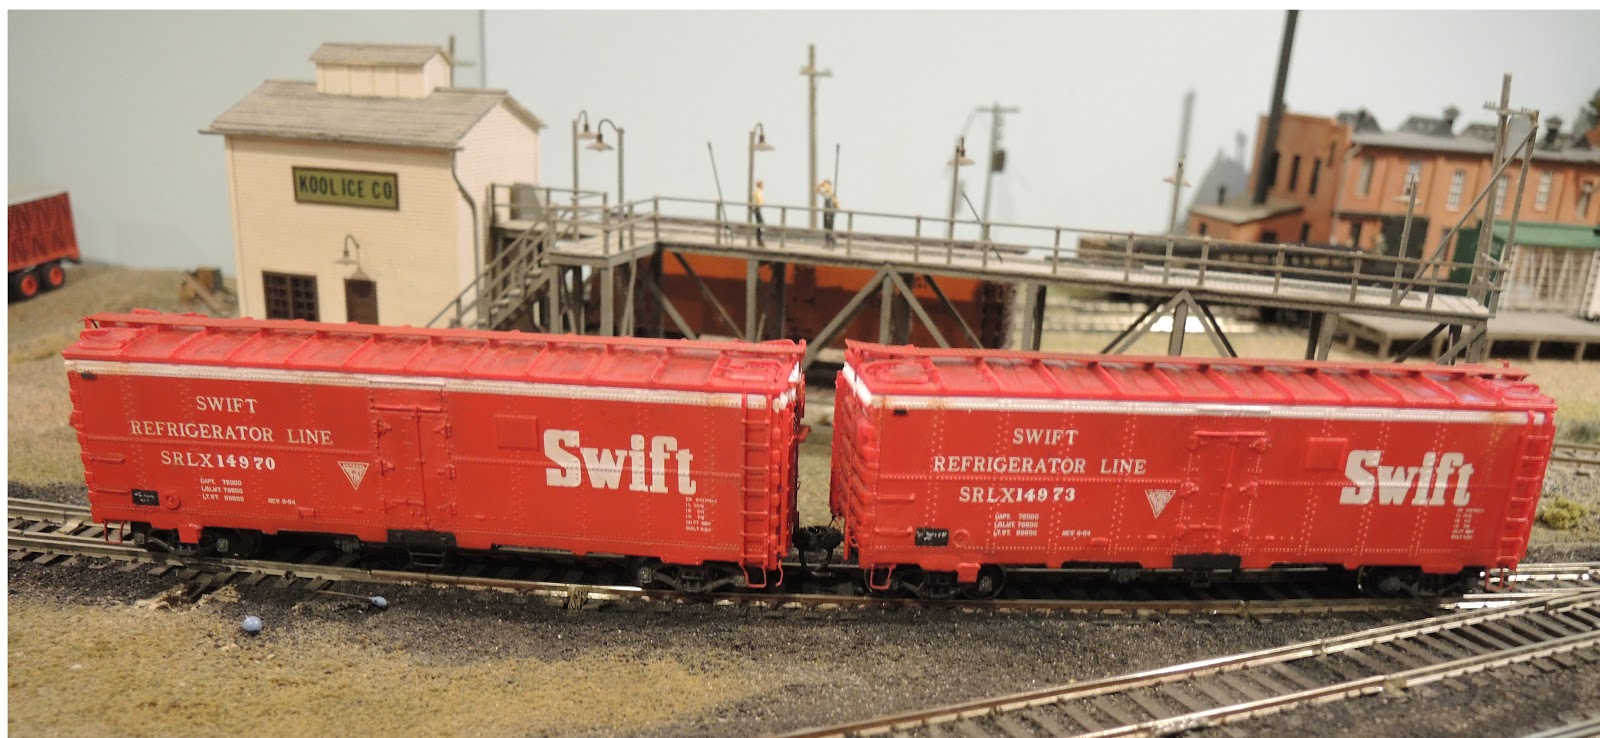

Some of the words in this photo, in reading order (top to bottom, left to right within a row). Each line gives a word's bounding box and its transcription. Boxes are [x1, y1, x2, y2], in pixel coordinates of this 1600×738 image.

[300, 175, 337, 196] KOOL
[341, 178, 364, 198] ICE
[371, 181, 393, 200] CO
[195, 396, 258, 414] SWIFT
[130, 420, 275, 443] REFRIGERATOR
[286, 428, 334, 446] LINE
[1012, 427, 1079, 446] SWIFT
[543, 428, 697, 496] Swift
[932, 455, 1087, 475] REFRIGERATOR
[1099, 458, 1147, 476] LINE
[1338, 449, 1475, 507] Swift
